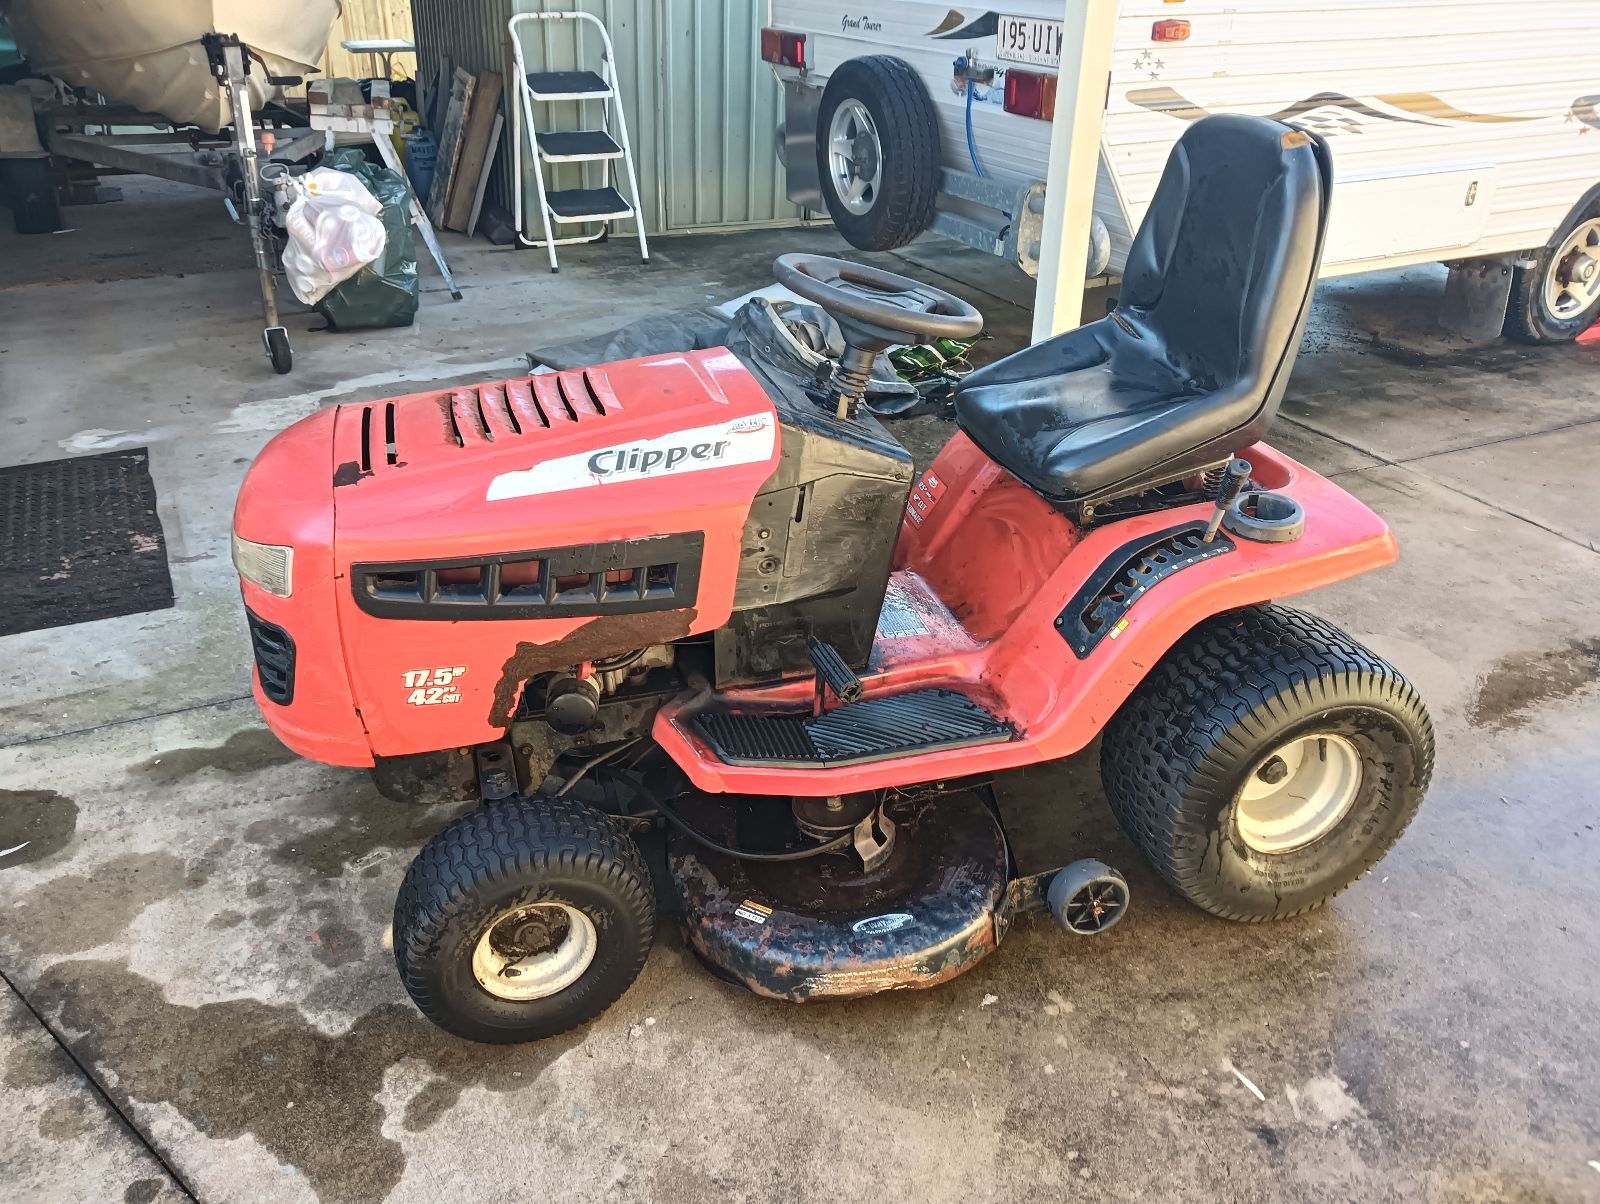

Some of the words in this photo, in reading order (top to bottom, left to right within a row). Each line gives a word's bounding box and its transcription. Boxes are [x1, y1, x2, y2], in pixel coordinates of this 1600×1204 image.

[587, 440, 731, 476] Clipper
[401, 668, 454, 688] 17.5
[441, 693, 463, 704] CUT
